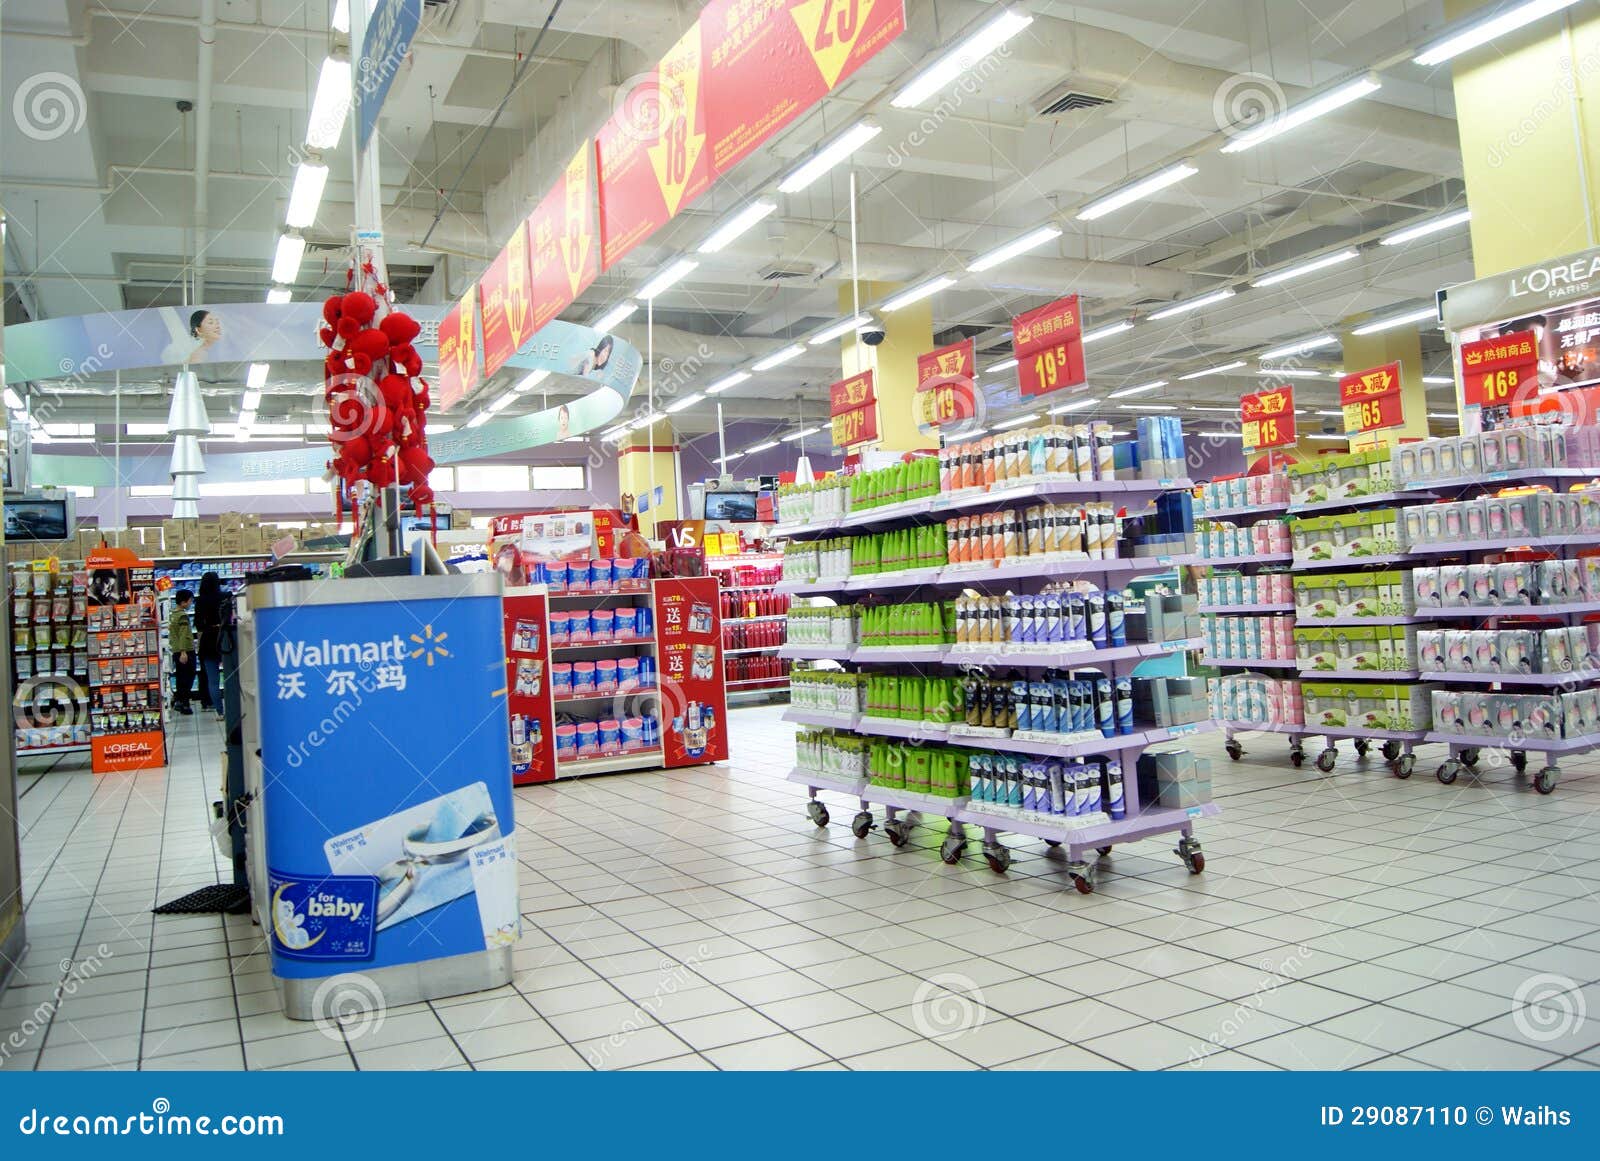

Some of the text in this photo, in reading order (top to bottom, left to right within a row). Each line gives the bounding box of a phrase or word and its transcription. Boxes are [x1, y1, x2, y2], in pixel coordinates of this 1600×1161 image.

[1548, 281, 1590, 299] PARIS
[1032, 310, 1075, 338] 热销商品
[1484, 341, 1532, 362] 热销商品
[1361, 399, 1381, 427] 65
[1261, 419, 1278, 444] 15
[673, 527, 696, 548] VS
[665, 607, 682, 624] 送
[273, 634, 405, 669] Walmart
[669, 655, 685, 672] 送
[277, 668, 407, 699] 沃尔玛
[103, 742, 153, 754] L'ORÉAL
[318, 891, 335, 902] for
[307, 896, 365, 923] baby
